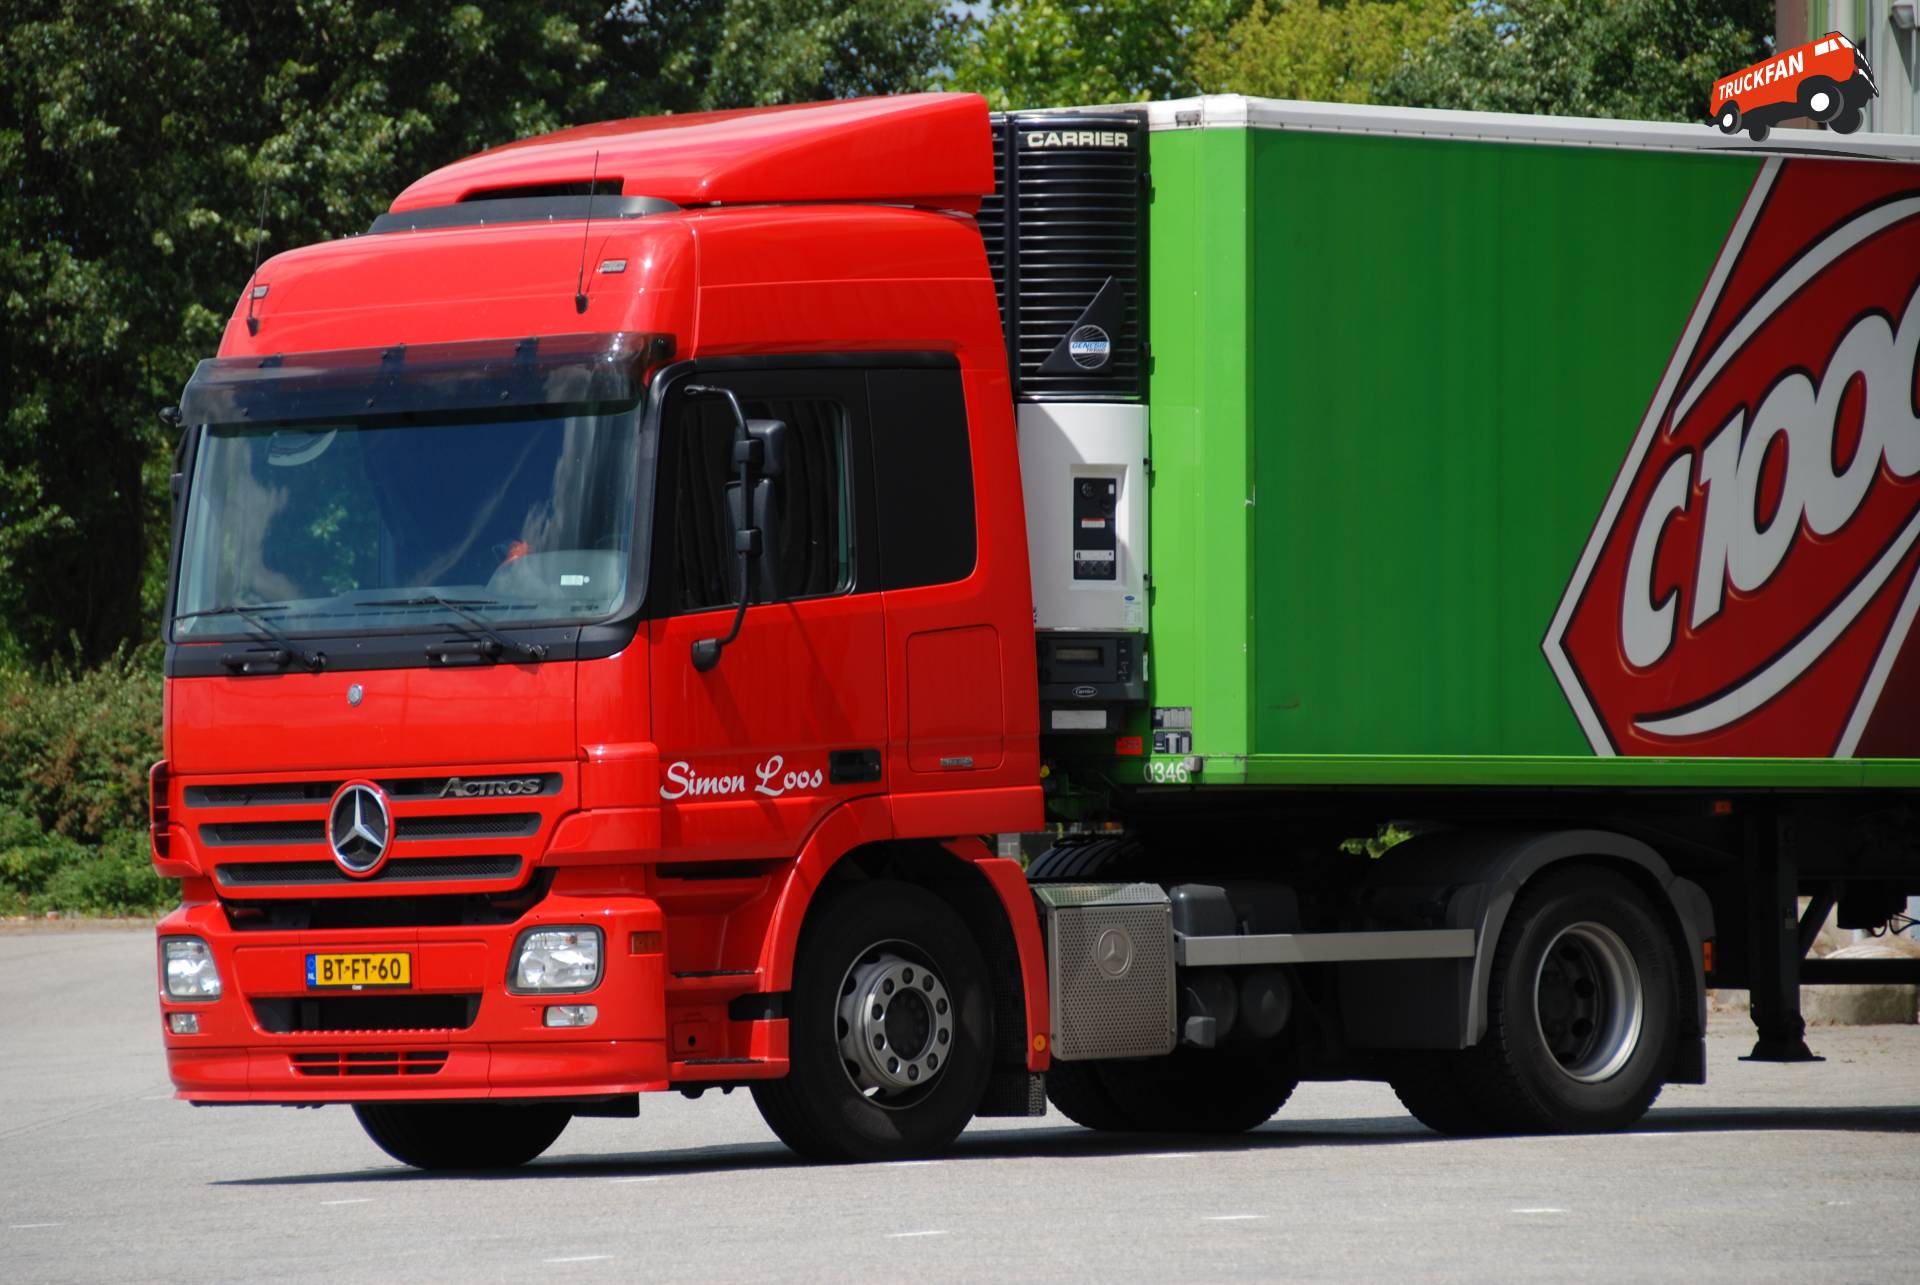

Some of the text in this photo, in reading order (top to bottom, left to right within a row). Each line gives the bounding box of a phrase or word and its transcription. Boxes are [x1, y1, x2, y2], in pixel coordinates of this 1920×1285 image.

[1027, 131, 1129, 147] CARRIER
[659, 755, 823, 799] Simon Loos
[1144, 762, 1188, 784] 0346
[323, 958, 401, 980] BT-FT-60
